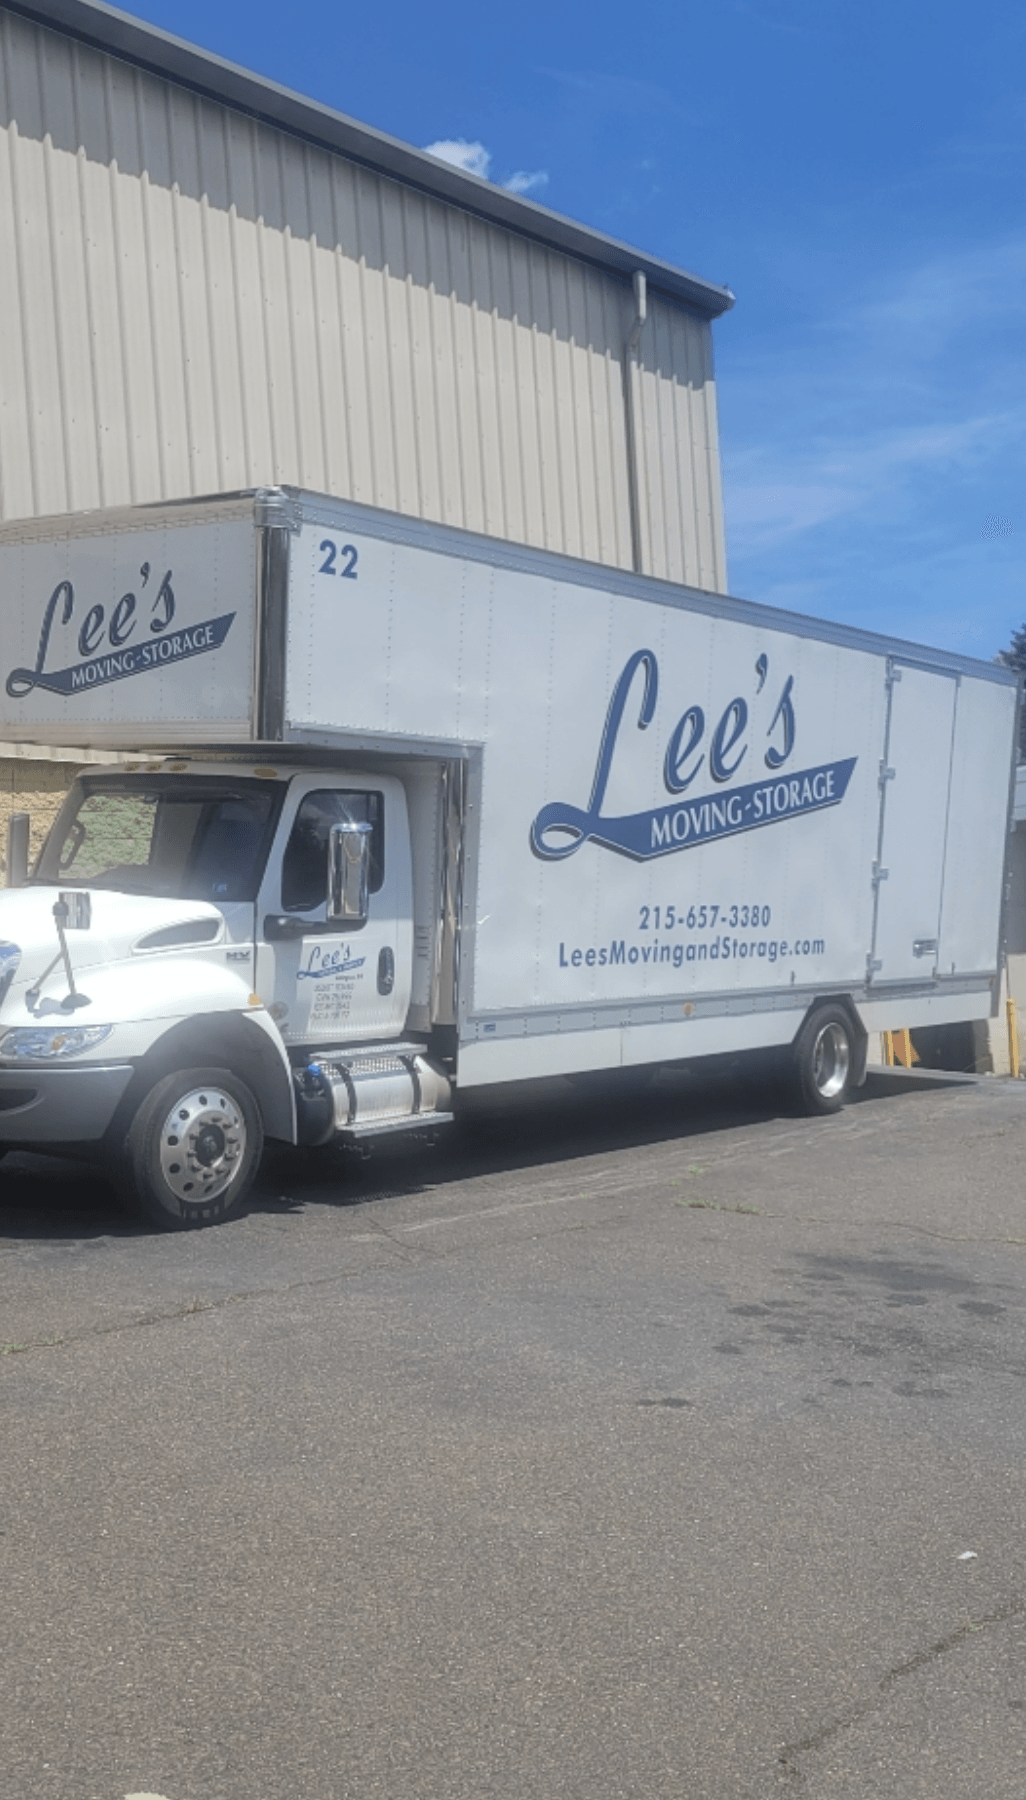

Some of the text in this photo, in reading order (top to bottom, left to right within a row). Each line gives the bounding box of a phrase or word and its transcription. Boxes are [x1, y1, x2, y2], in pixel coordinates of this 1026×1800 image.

[318, 539, 358, 579] 22
[6, 561, 176, 698] Lee's
[530, 648, 796, 862] Lee's
[638, 905, 771, 930] 215-657-3380
[297, 942, 350, 980] Lee's
[559, 937, 825, 967] LeesMovingandStorage.com
